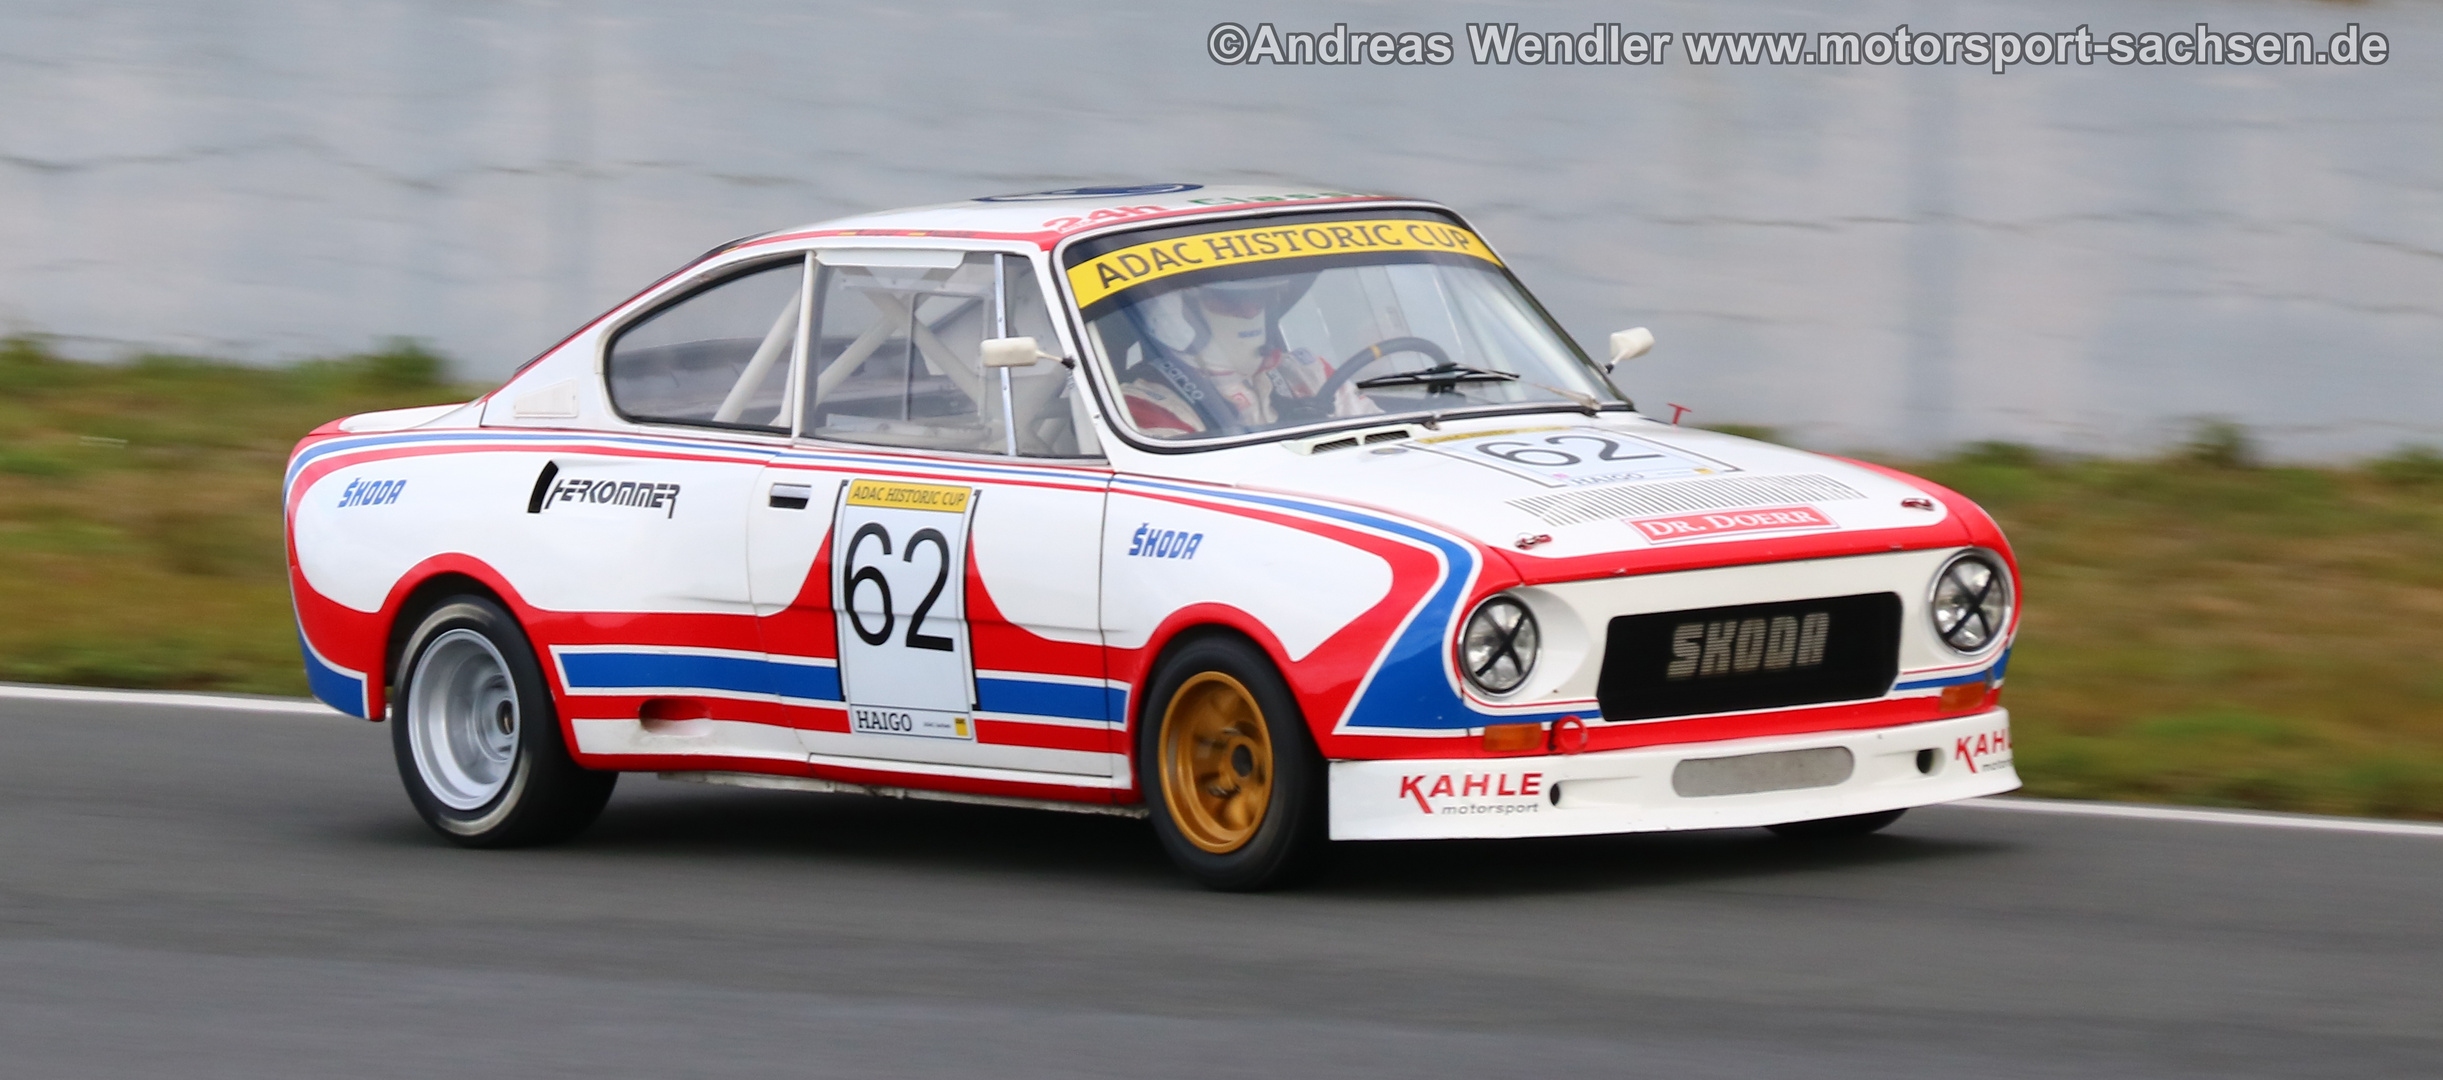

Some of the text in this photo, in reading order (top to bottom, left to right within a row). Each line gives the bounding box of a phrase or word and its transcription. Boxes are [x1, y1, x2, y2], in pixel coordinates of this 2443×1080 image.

[1096, 224, 1470, 289] ADAC HISTORIC CUP
[1475, 435, 1664, 467] 62
[852, 486, 966, 506] ADAC HISTORIC CUP
[1642, 511, 1819, 537] DR. DOERR
[845, 522, 954, 652] 62
[1666, 612, 1830, 679] SKODA
[857, 710, 913, 732] HAIGO
[1399, 773, 1543, 814] KAHLE
[1441, 803, 1539, 815] motorsport
